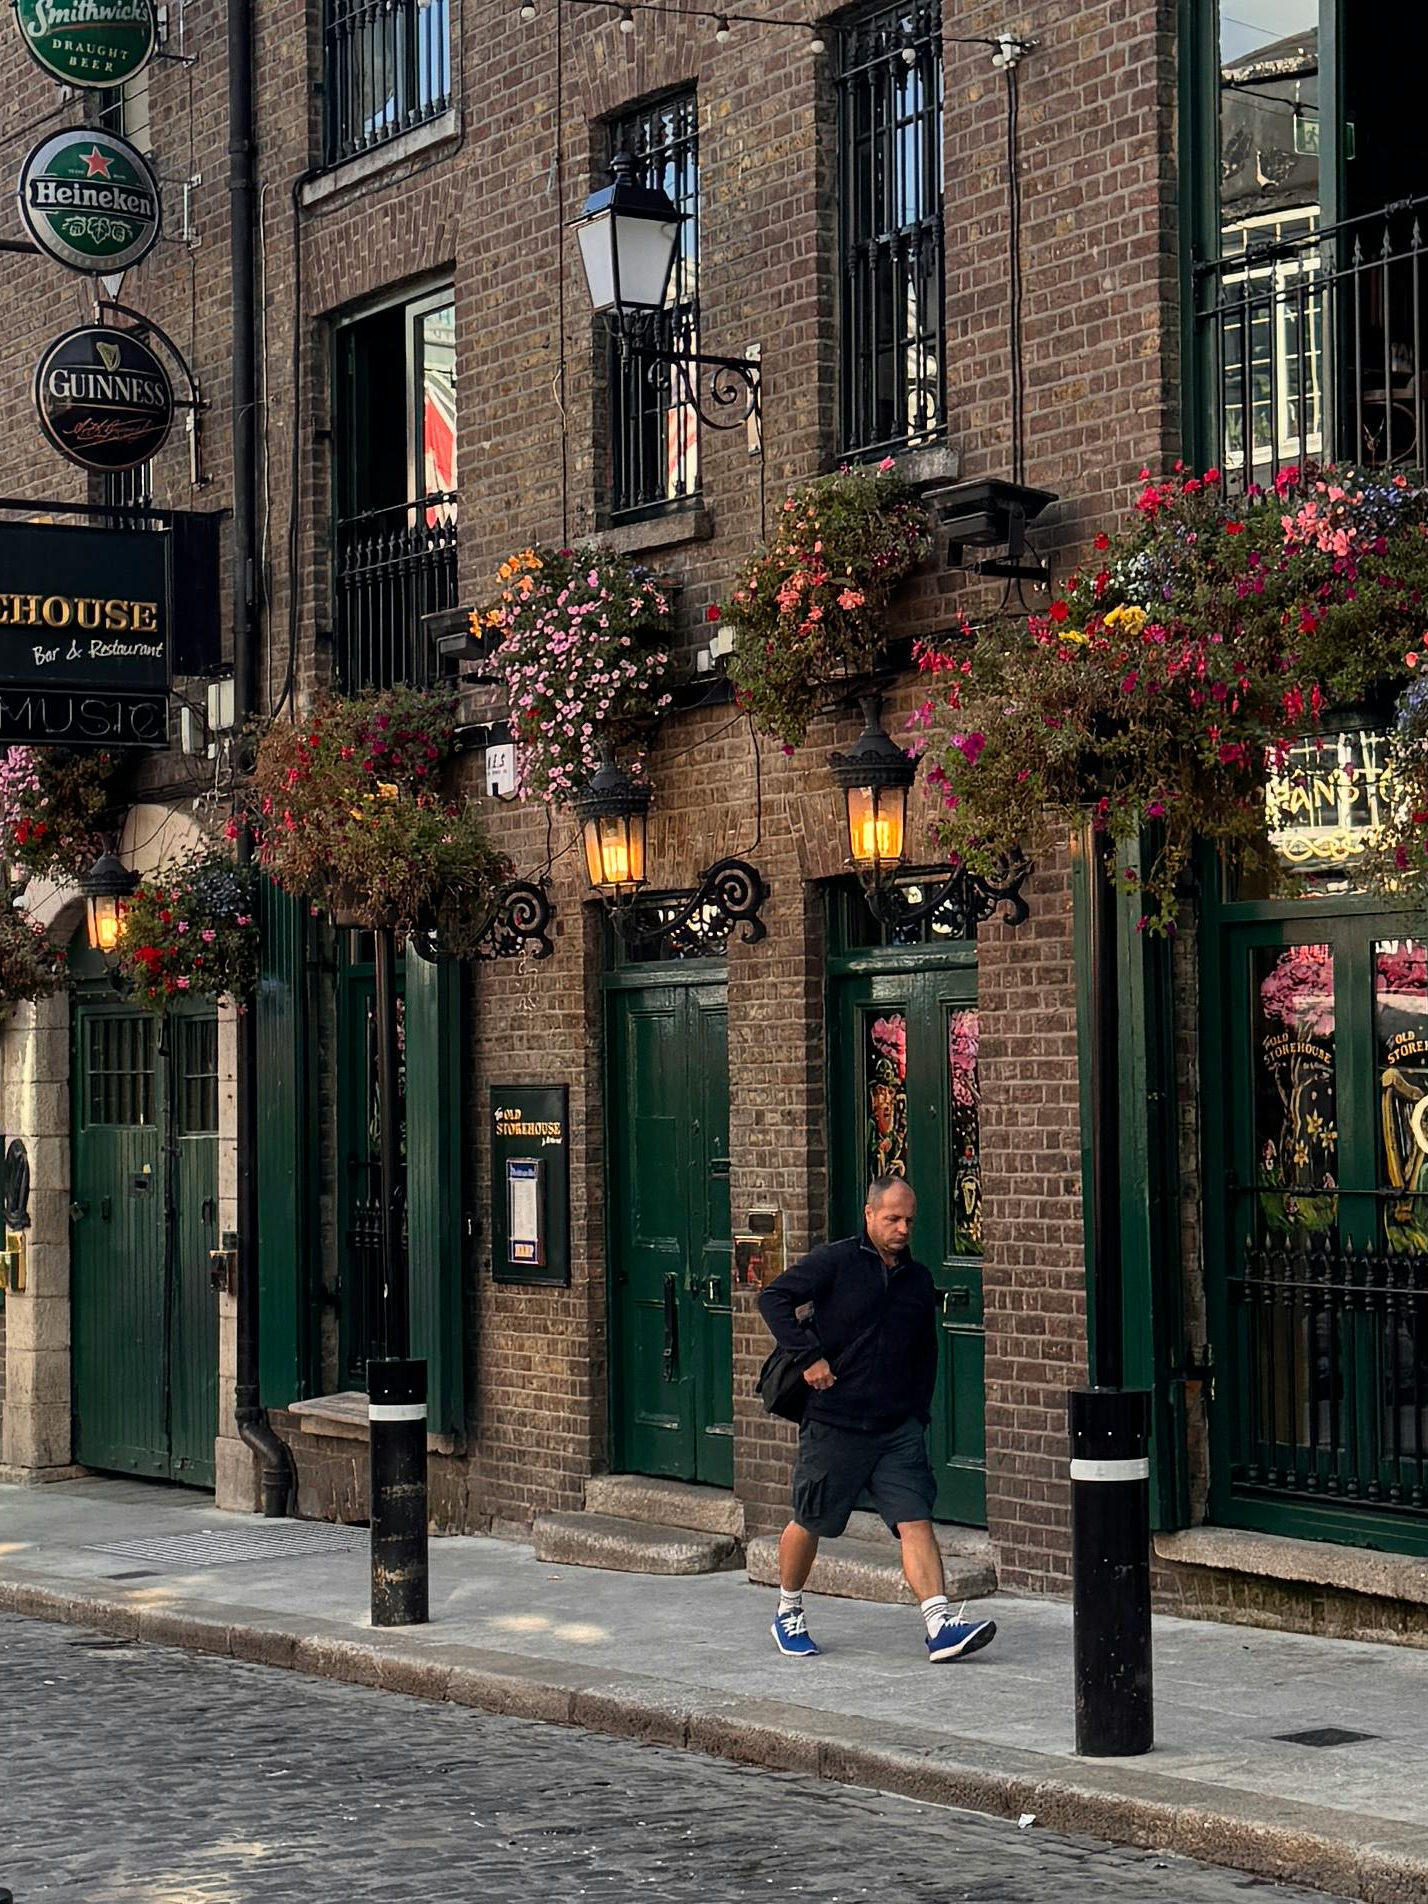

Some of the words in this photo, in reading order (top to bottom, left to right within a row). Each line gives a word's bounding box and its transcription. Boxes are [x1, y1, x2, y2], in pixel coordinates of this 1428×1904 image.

[52, 38, 129, 60] DRAUGHT
[69, 56, 113, 72] BEER
[36, 181, 152, 216] Heineken
[48, 369, 165, 407] GUINNESS
[32, 645, 60, 666] Bar
[66, 640, 82, 660] &
[88, 639, 164, 659] Restaurant
[1395, 1030, 1416, 1045] OLD
[1263, 1042, 1333, 1065] STOREHOUSE
[496, 1122, 561, 1136] STOREHOUSE
